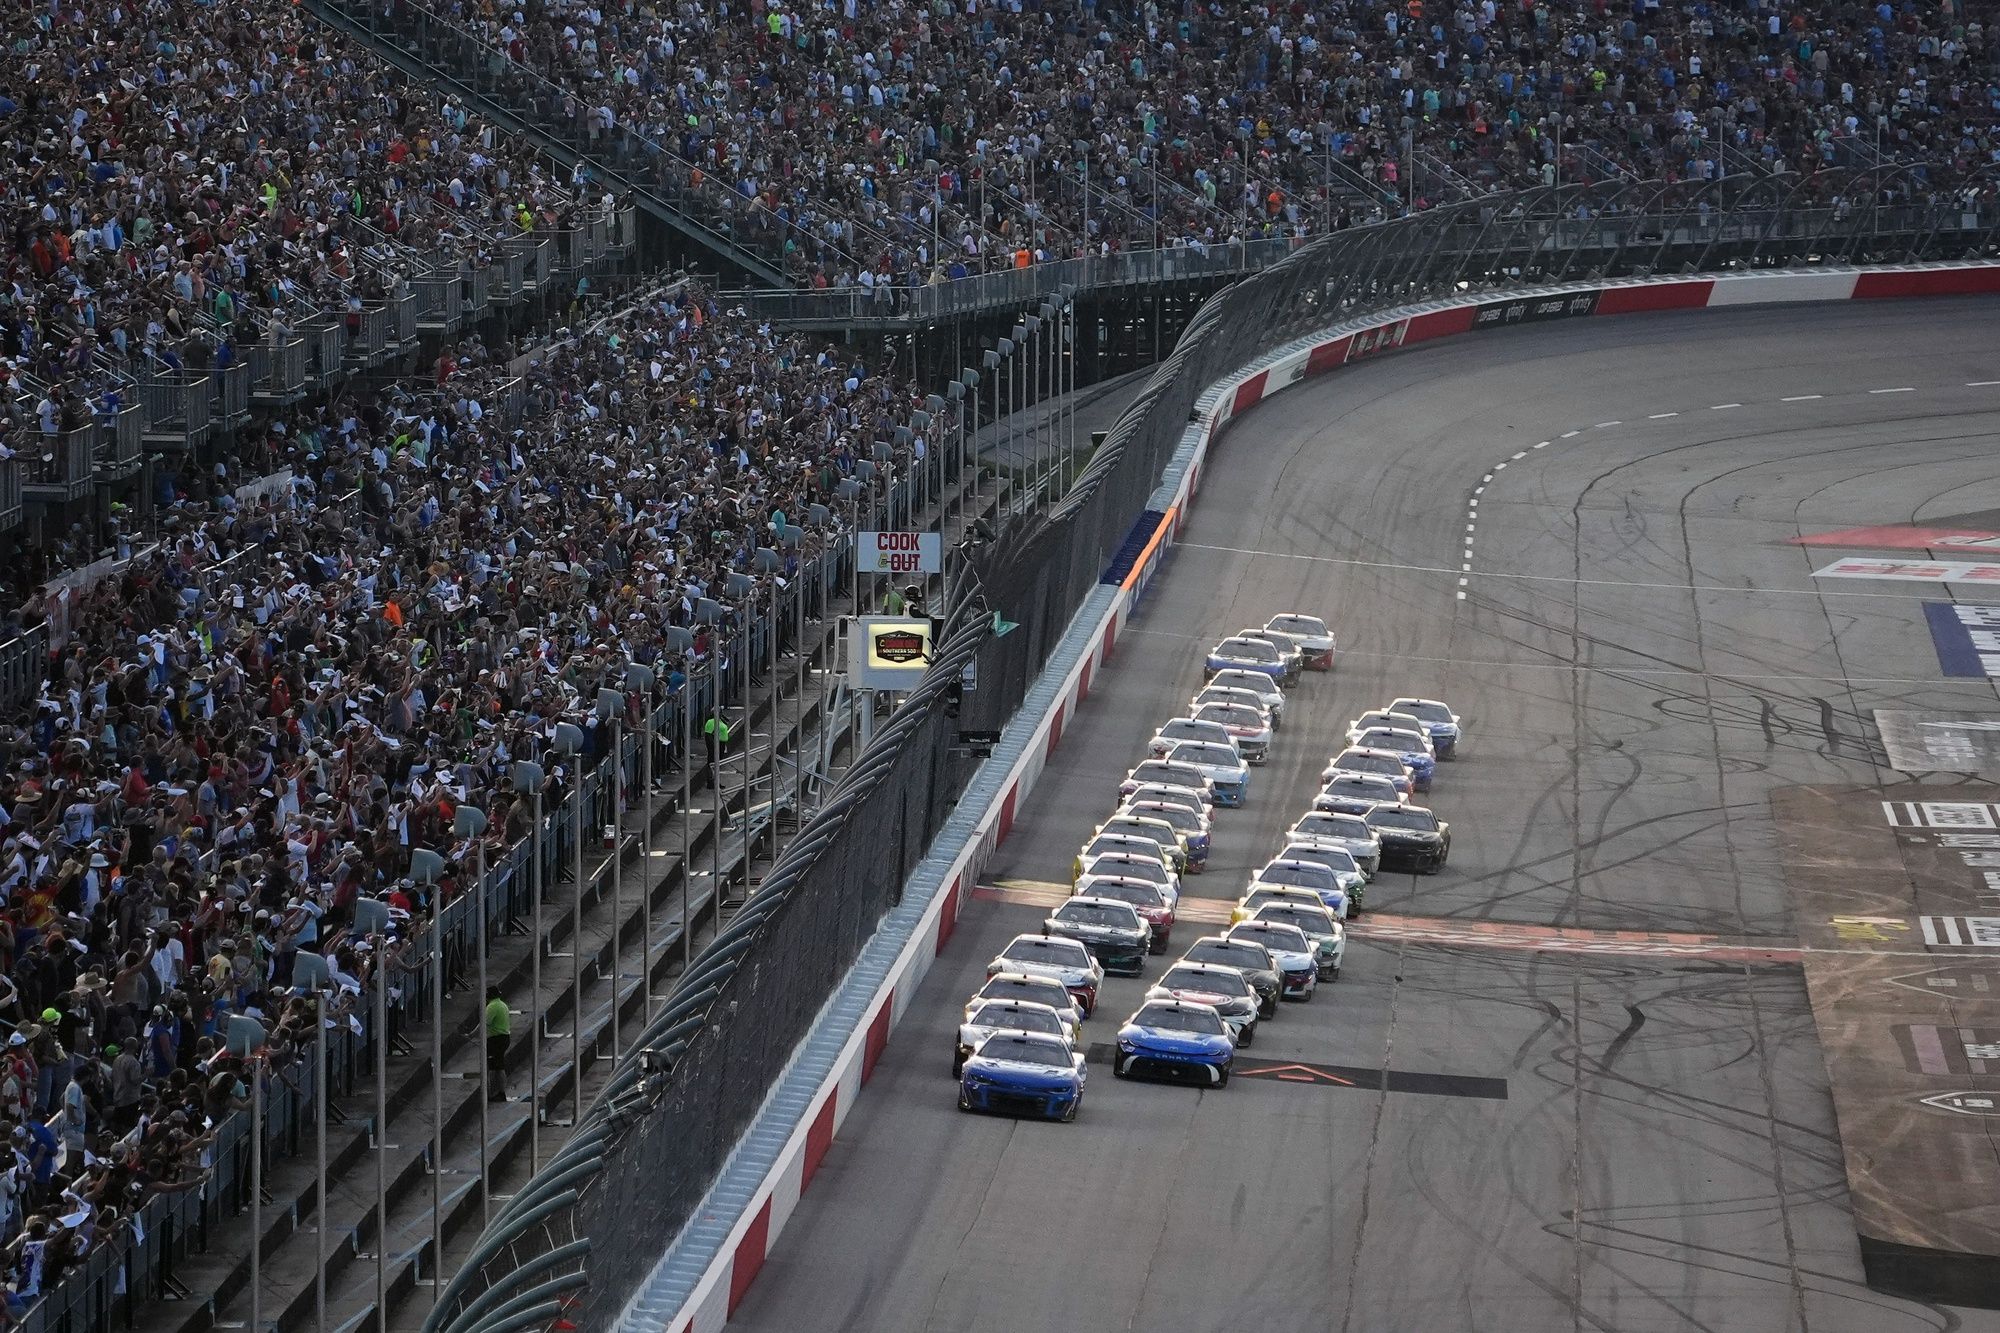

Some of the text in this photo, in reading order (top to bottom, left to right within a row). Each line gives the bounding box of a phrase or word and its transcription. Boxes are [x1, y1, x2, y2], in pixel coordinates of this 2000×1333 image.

[878, 533, 920, 551] COOK
[891, 553, 921, 571] OUT
[1154, 1053, 1189, 1061] CAMRY
